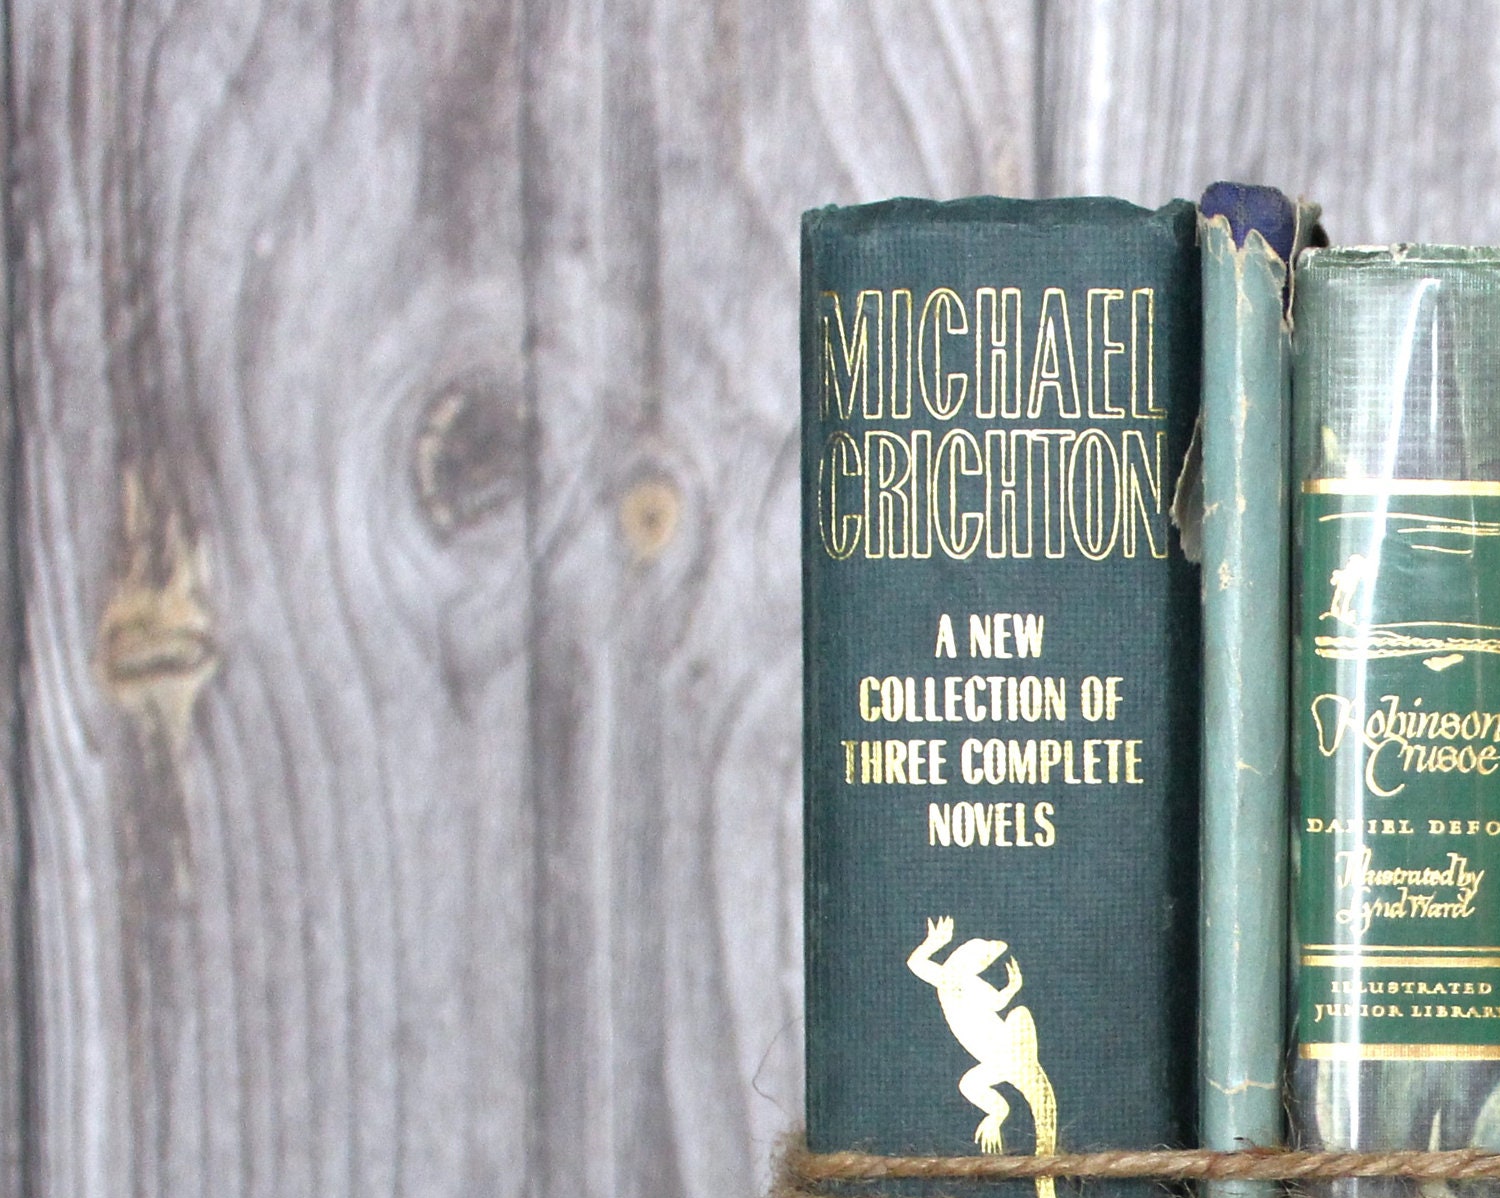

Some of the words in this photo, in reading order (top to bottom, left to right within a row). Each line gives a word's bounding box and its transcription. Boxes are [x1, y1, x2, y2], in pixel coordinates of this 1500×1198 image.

[819, 287, 1168, 421] MICHAEL
[818, 427, 1170, 561] CRICHTON
[935, 612, 957, 659] A
[969, 612, 1045, 659] NEW
[858, 675, 1067, 723] COLLECTION
[1080, 676, 1124, 722] OF
[841, 739, 948, 786] THREE
[960, 739, 1144, 786] COMPLETE
[928, 801, 1056, 848] NOVELS
